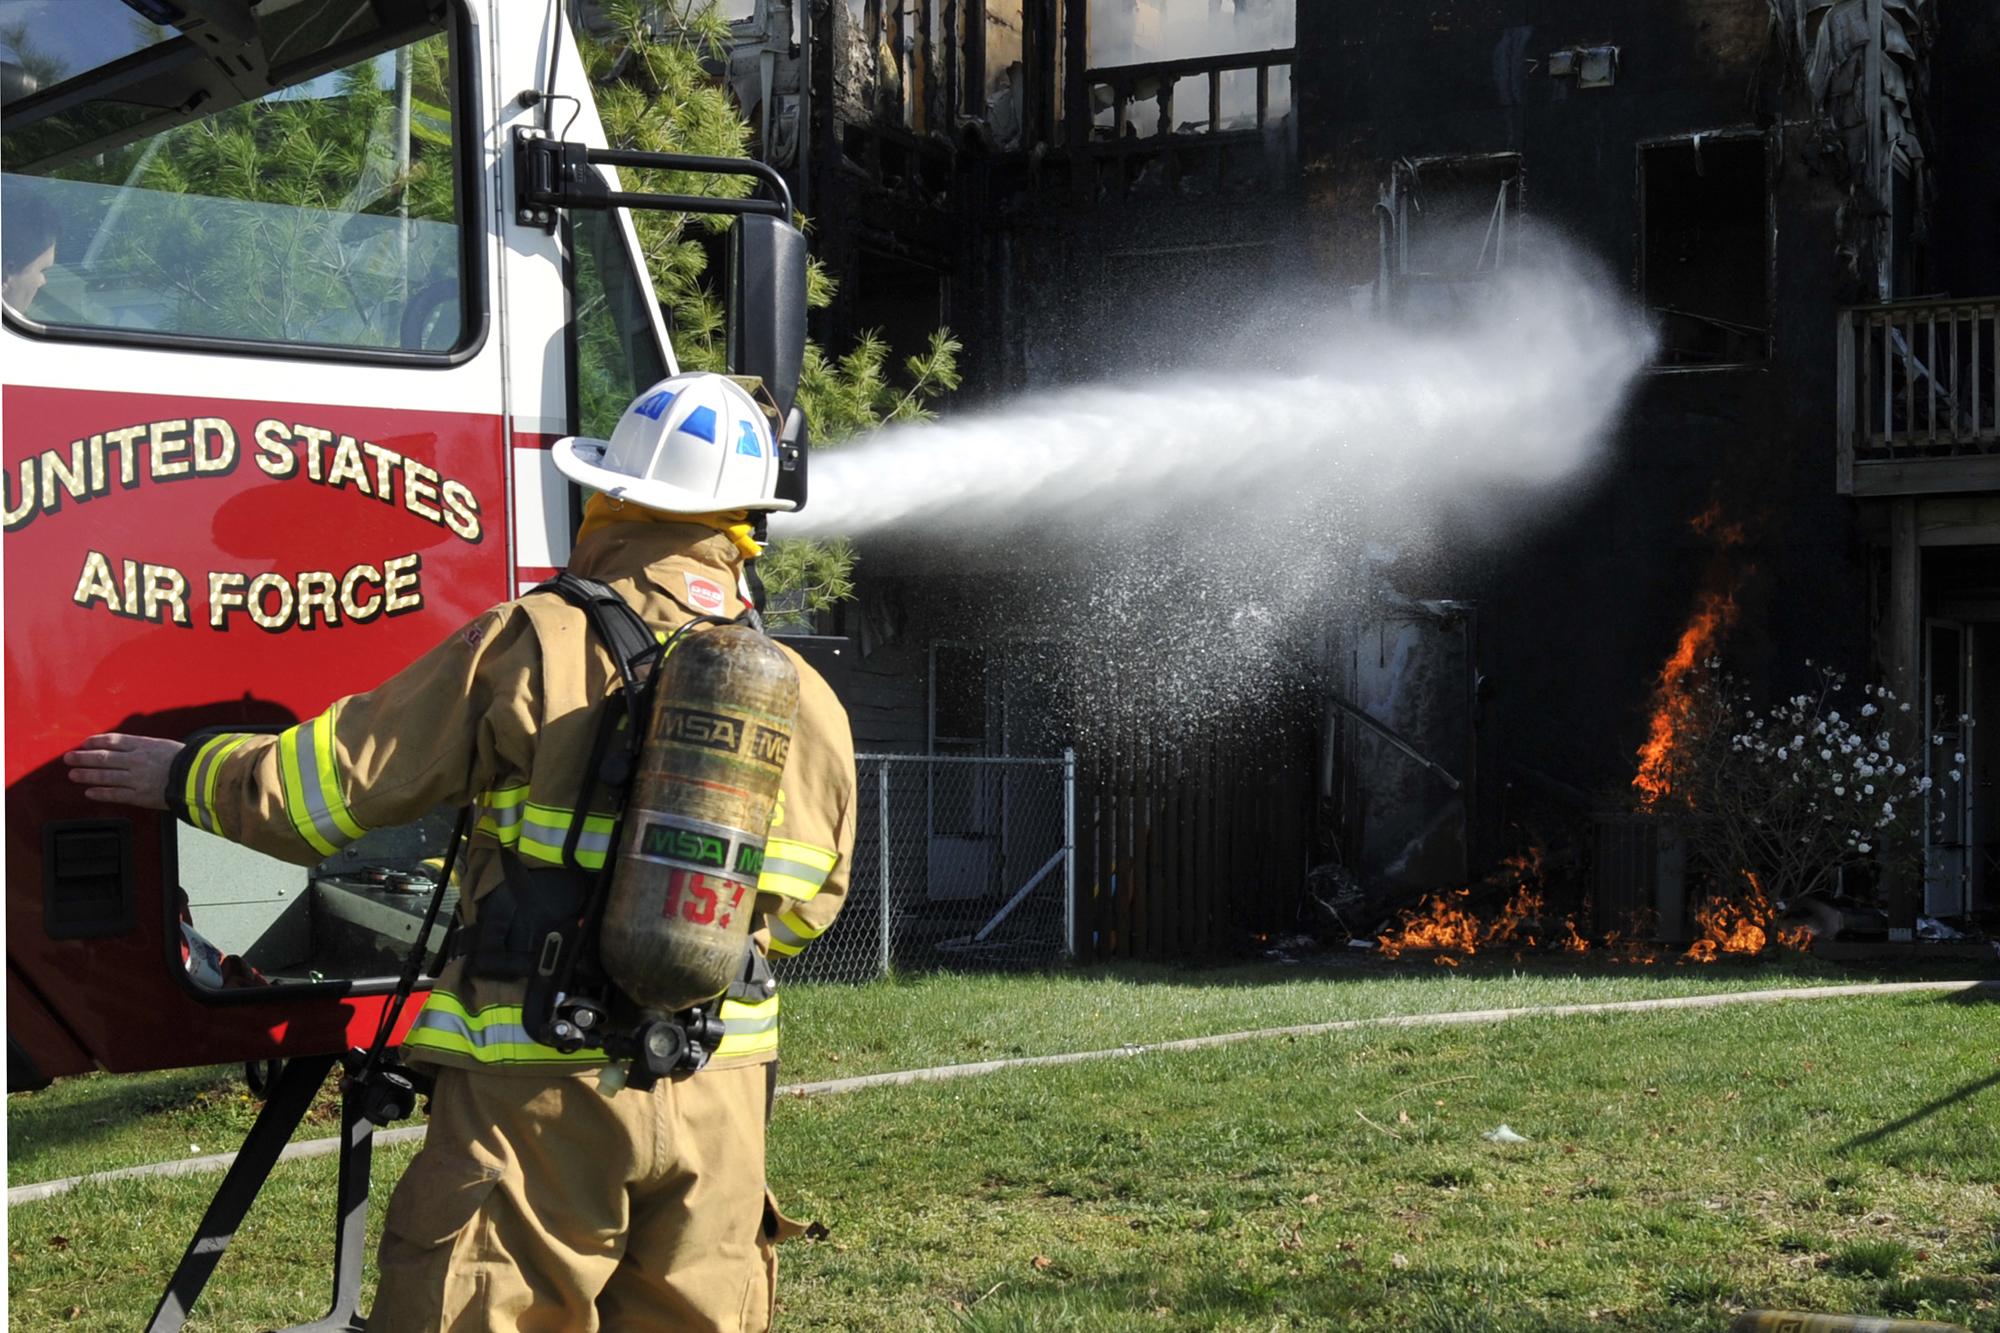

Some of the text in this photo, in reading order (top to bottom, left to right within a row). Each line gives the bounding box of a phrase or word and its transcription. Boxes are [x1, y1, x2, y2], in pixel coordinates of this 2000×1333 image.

[3, 417, 483, 543] UNITED STATES
[73, 549, 424, 633] AIR FORCE
[658, 711, 736, 749] MSA
[646, 828, 723, 865] MSA
